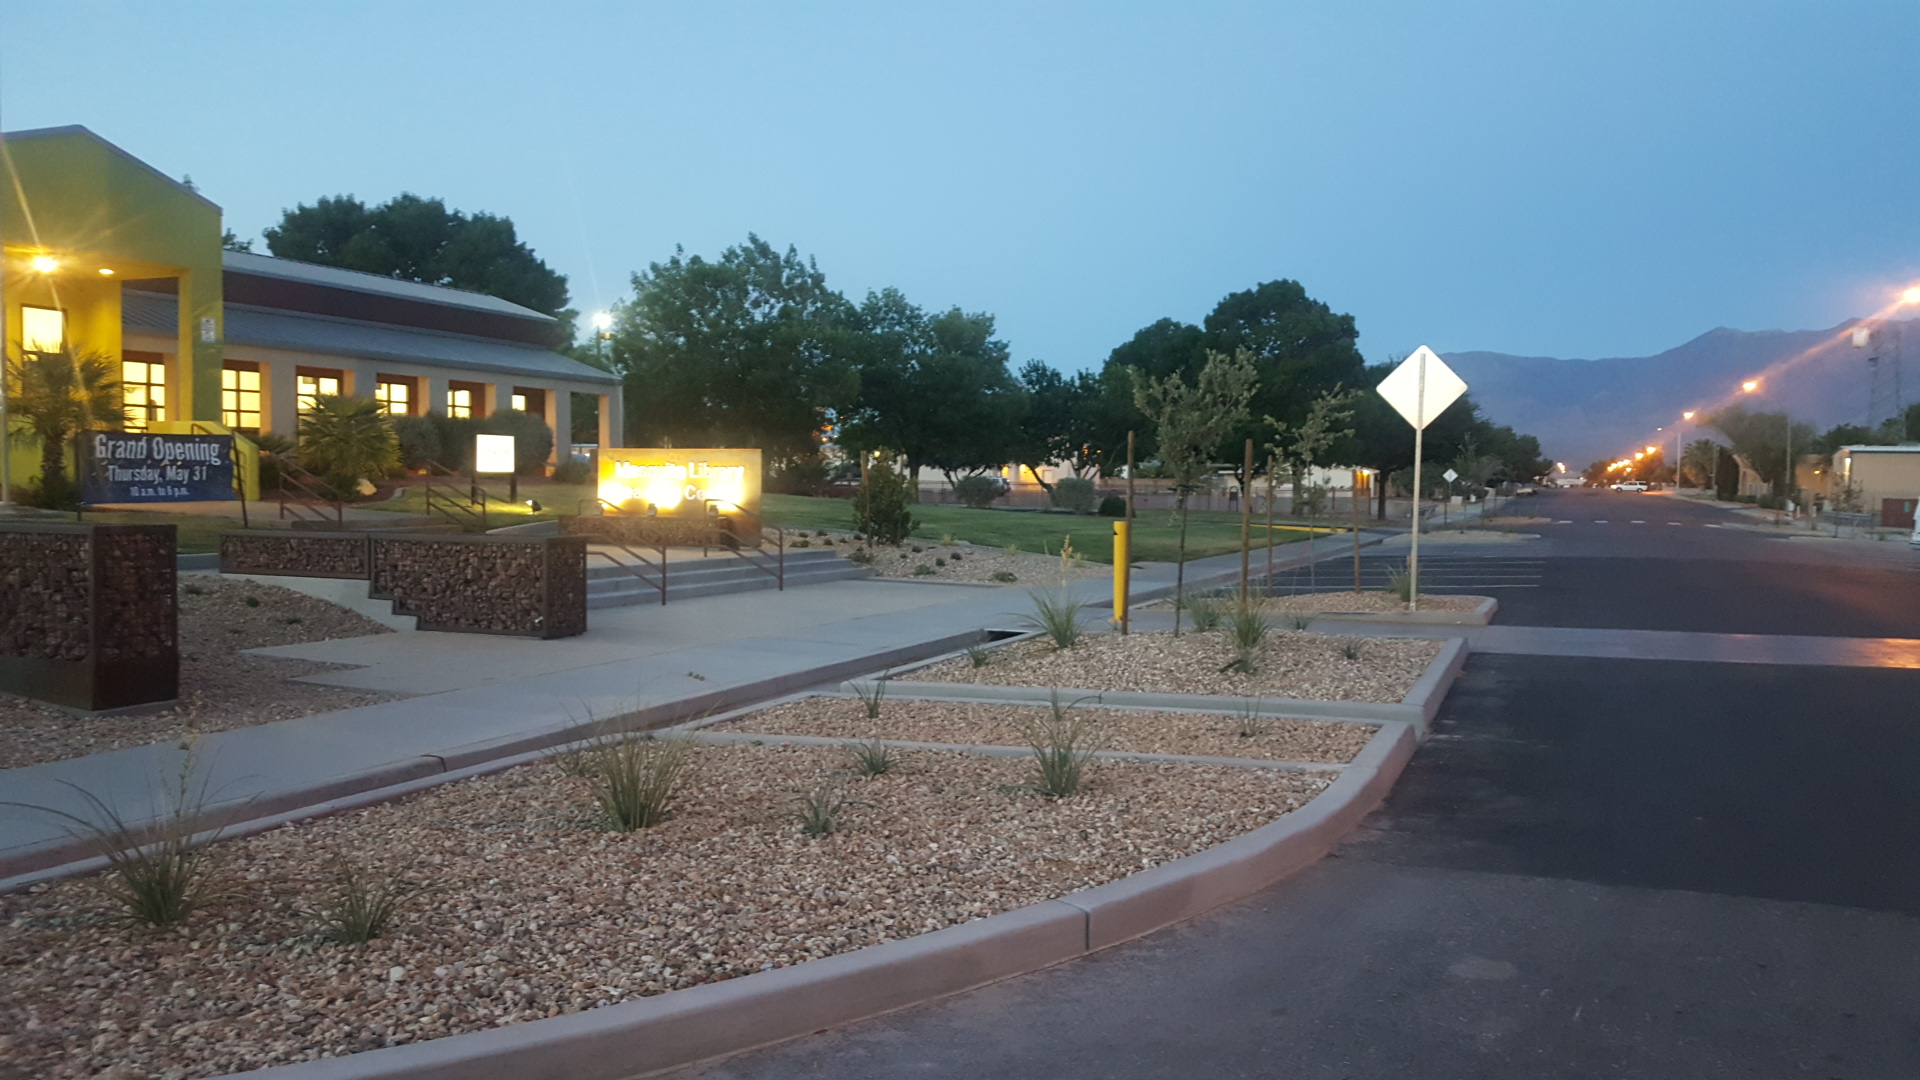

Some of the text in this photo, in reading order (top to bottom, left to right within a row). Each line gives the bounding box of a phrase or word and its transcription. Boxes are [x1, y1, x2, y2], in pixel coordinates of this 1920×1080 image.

[96, 434, 221, 465] Grand Opening
[108, 465, 207, 484] Thursday, May 31
[689, 462, 745, 484] Library
